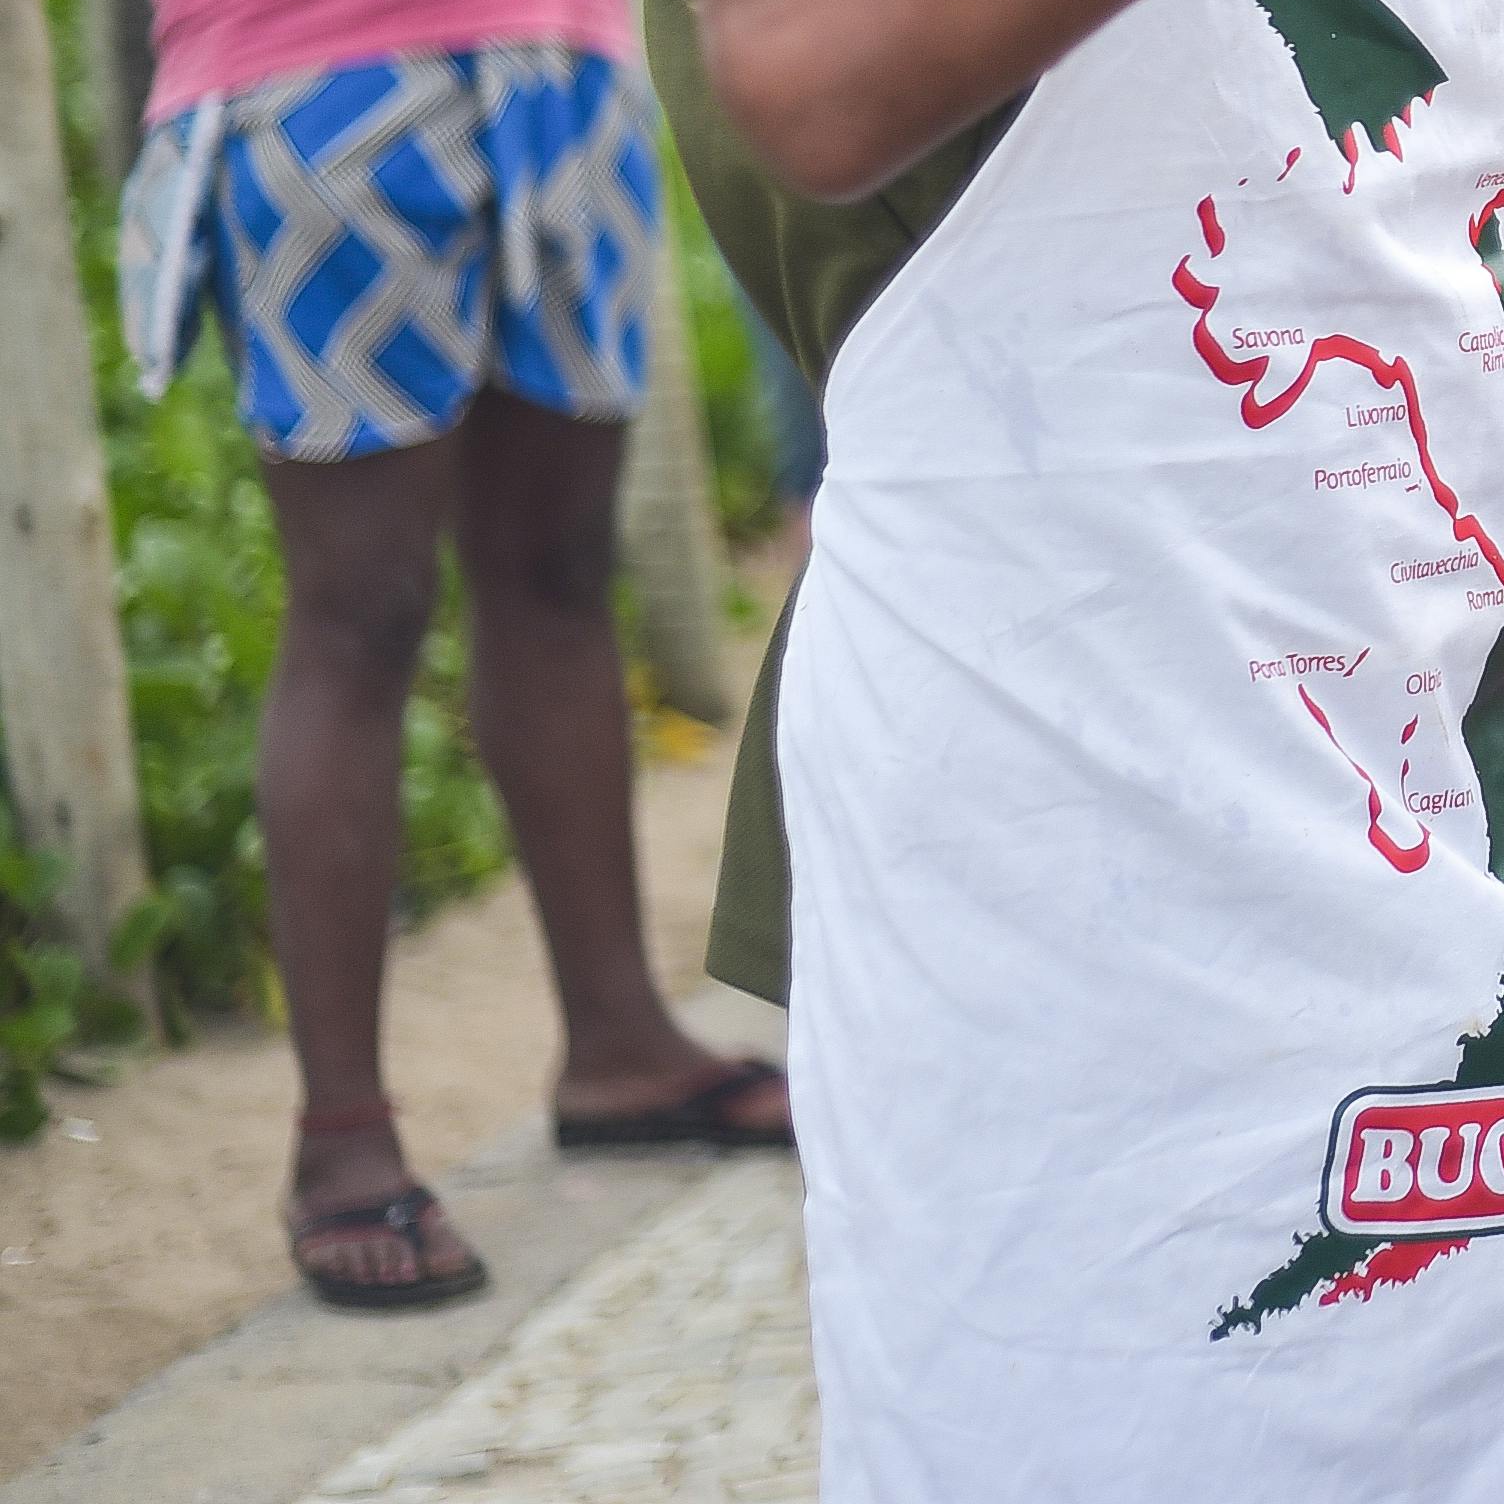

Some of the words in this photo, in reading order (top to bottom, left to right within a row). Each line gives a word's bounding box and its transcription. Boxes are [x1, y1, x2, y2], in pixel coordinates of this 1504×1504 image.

[1232, 327, 1305, 349] Savona
[1346, 404, 1407, 428] Livorno
[1314, 457, 1412, 491] Portoferraio
[1390, 548, 1479, 584] Civitavecchia
[1466, 588, 1504, 612] Roma
[1286, 653, 1346, 675] Torres
